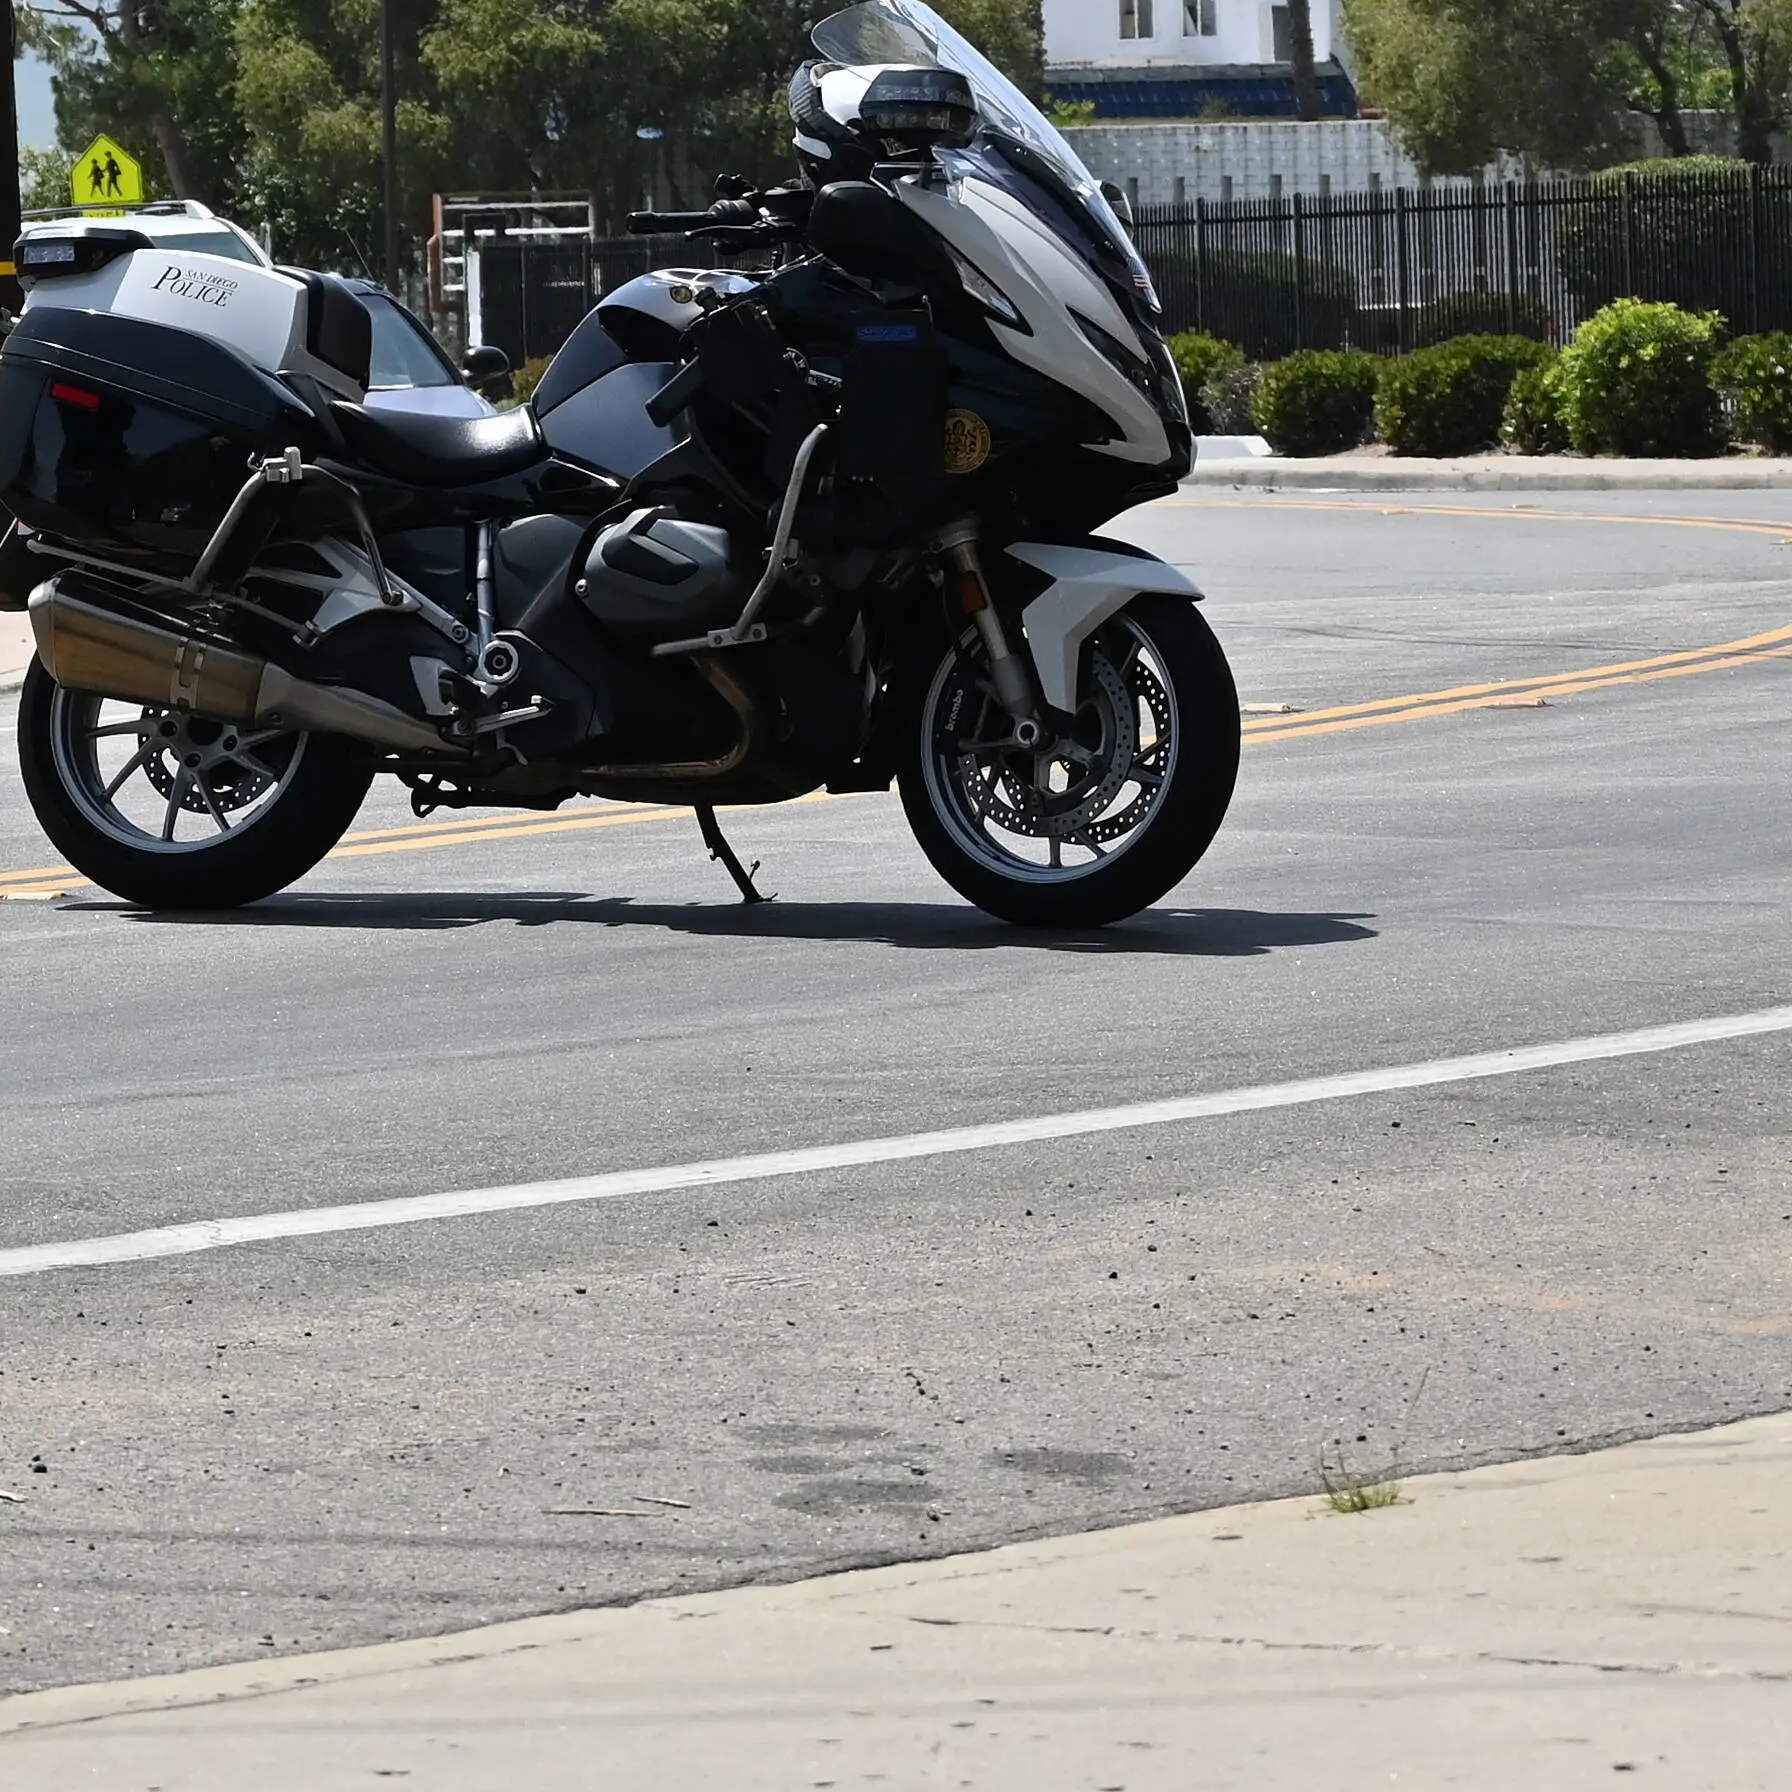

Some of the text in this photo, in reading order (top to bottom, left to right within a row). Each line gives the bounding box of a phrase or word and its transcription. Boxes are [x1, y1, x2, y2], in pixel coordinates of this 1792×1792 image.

[151, 265, 232, 307] POLICE
[185, 269, 238, 289] SAN DIEGO
[944, 689, 964, 732] brembo
